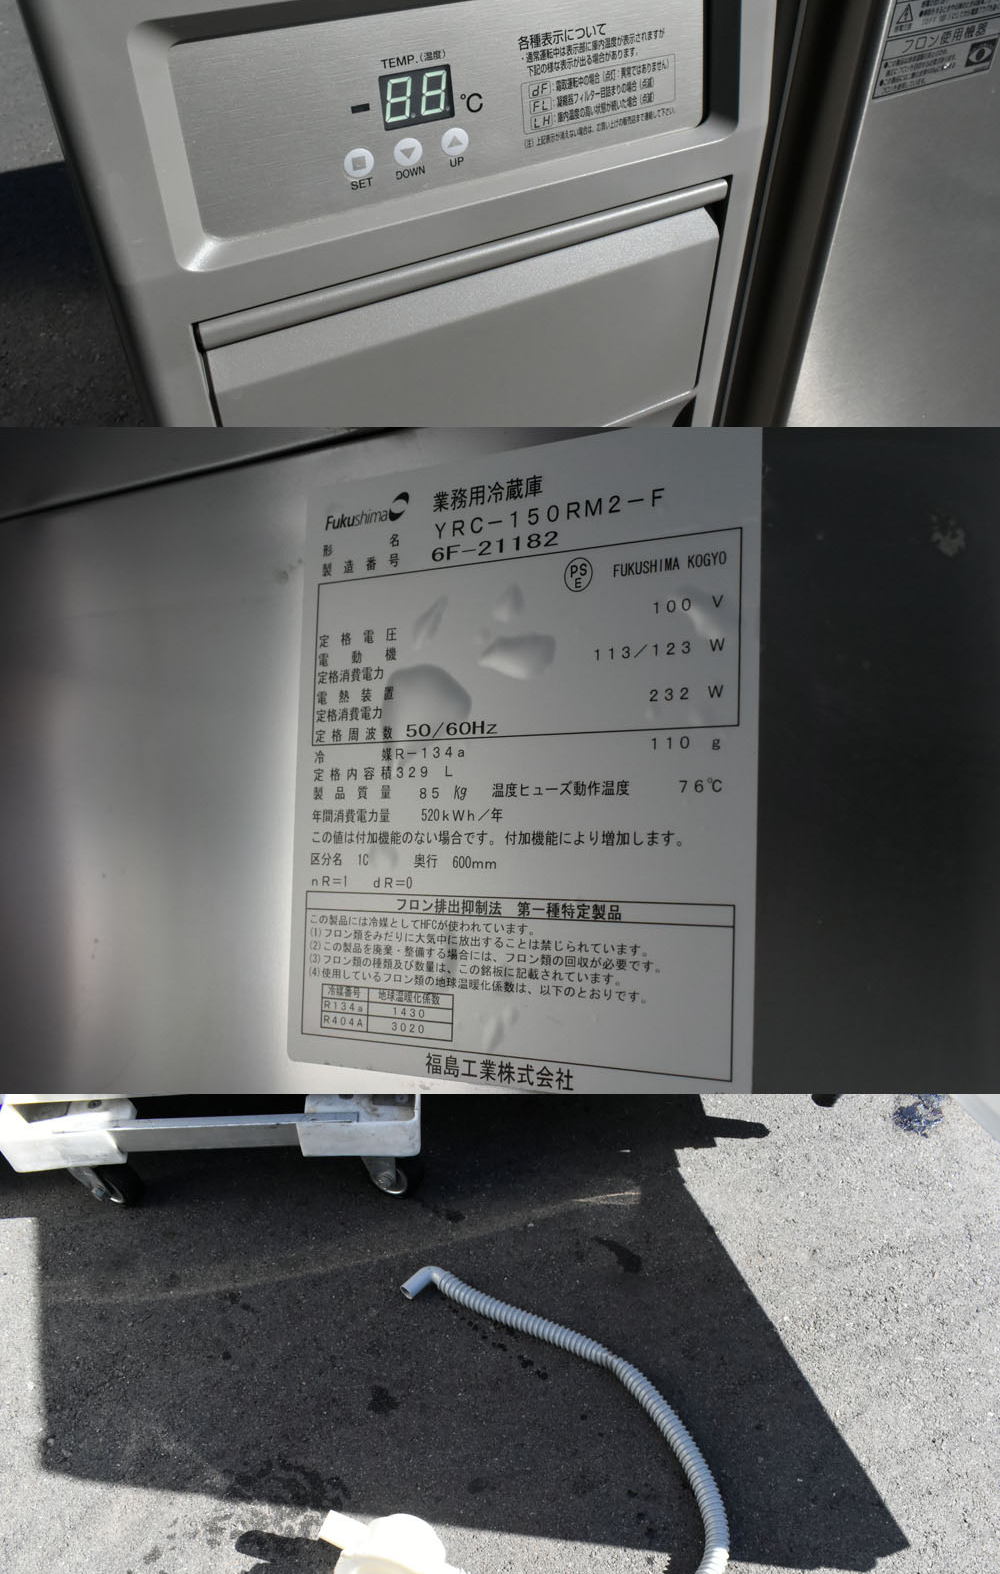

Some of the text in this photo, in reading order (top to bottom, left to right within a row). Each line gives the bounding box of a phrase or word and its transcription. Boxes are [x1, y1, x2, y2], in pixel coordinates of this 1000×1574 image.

[518, 23, 607, 51] 各種表示について
[902, 21, 988, 53] フロン使用機器
[385, 69, 447, 123] 88
[532, 100, 548, 113] FL
[533, 115, 550, 129] LH
[450, 156, 464, 168] UP
[396, 165, 426, 180] DOWN
[351, 177, 373, 191] SET
[433, 475, 543, 513] 業務用冷蔵庫
[325, 509, 388, 531] Fukushima
[435, 488, 665, 539] YRC-150RM2-F
[431, 530, 558, 562] 6F-21182
[613, 551, 727, 578] FUKUSHIMA KOGYO
[654, 598, 691, 614] 100
[712, 594, 724, 608] V
[594, 640, 691, 661] 113/123
[710, 637, 725, 652] W
[317, 666, 384, 685] 定格消費電力
[649, 687, 689, 702] 232
[707, 684, 724, 699] W
[316, 706, 383, 723] 定格消費電力
[406, 721, 498, 738] 50/60Hz
[395, 746, 465, 760] R-134a
[651, 736, 690, 750] 110
[712, 738, 721, 751] g
[396, 766, 428, 778] 329
[445, 766, 453, 777] L
[420, 787, 439, 799] 85
[492, 779, 630, 798] 温度ヒューズ動作温度
[312, 809, 390, 824] 年間消費電力量
[311, 853, 497, 870] 区分名 1C 奥行 600mm
[396, 899, 622, 921] フロン排出抑制法 第一種特定製品
[310, 914, 534, 936] この製品には冷媒としてHFCが使われています。
[327, 986, 440, 1005] 冷媒番号 地球温暖化係数
[324, 1001, 425, 1018] R134a 1430
[323, 1014, 424, 1034] R404A 3020
[425, 1052, 574, 1091] 福島工業株式会社
